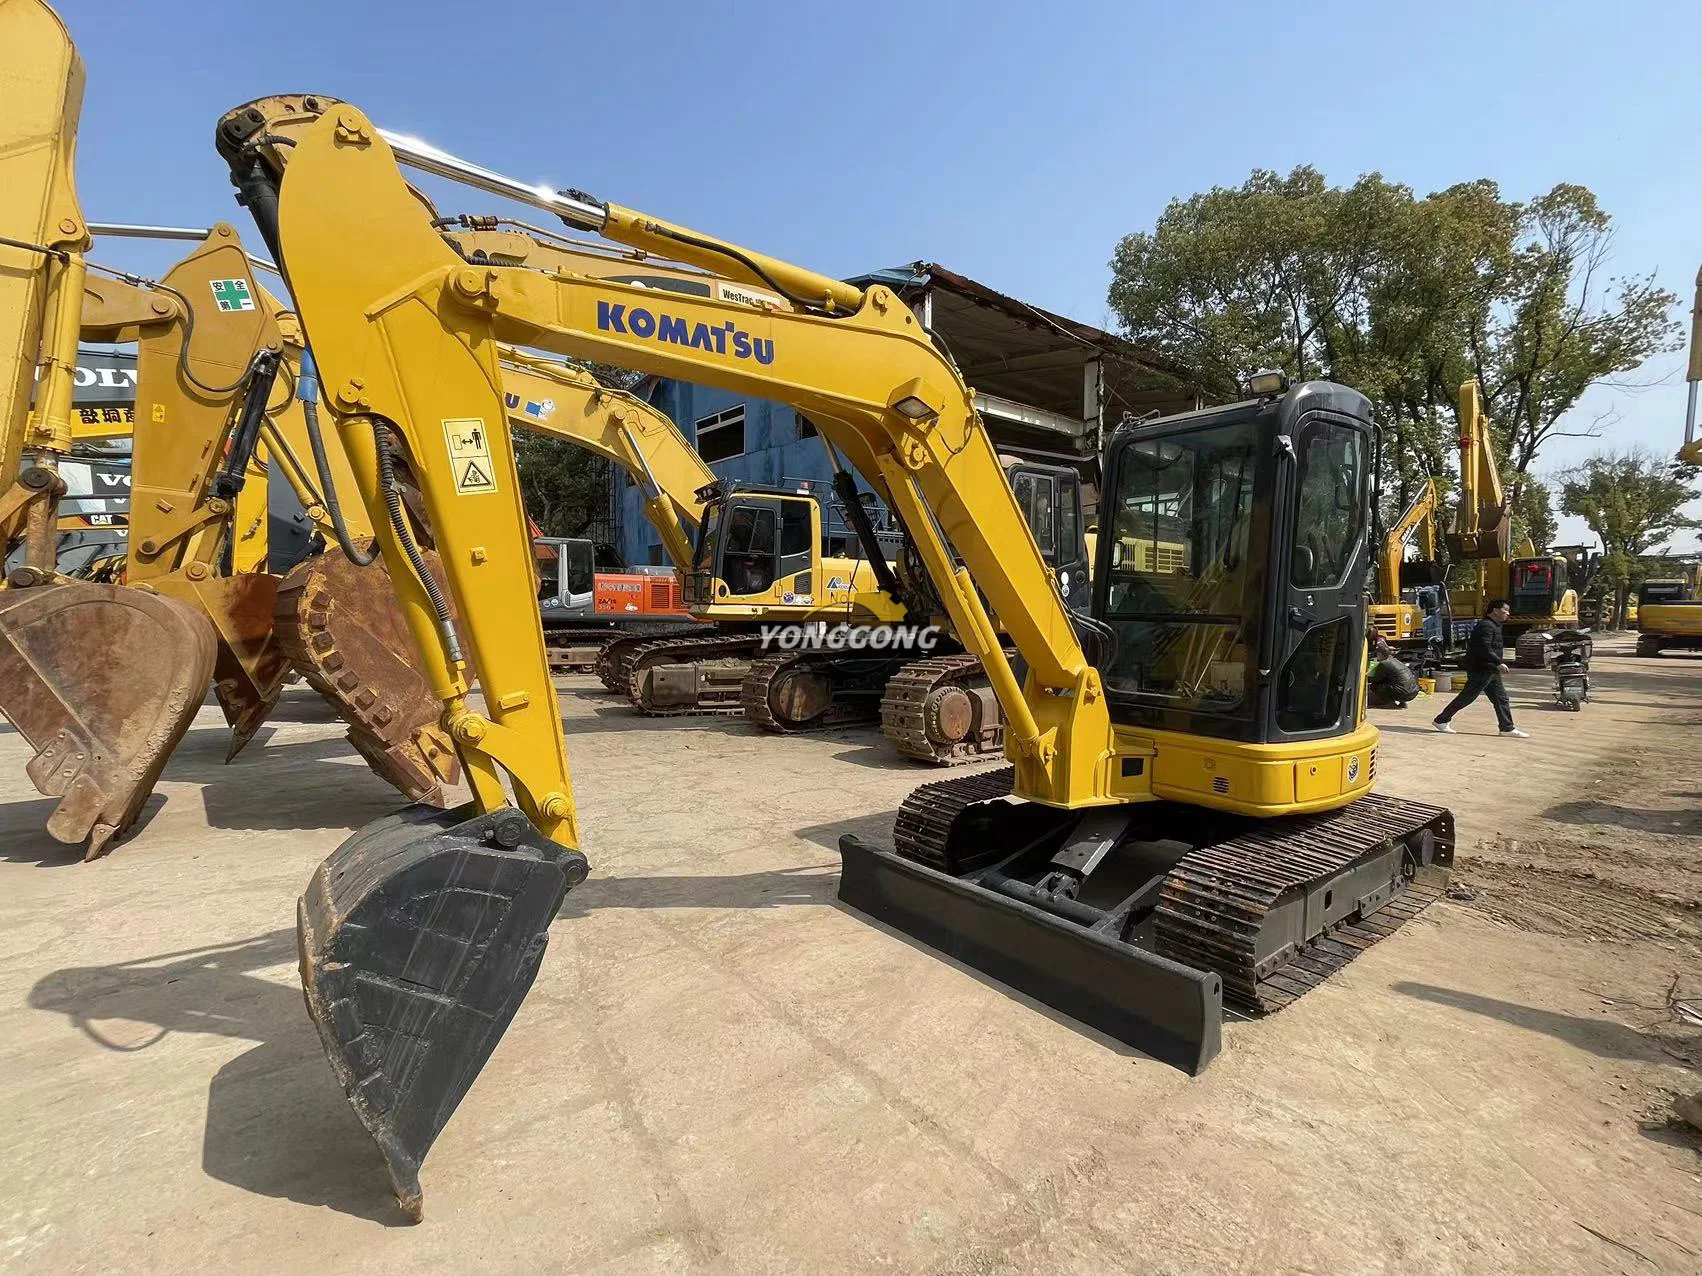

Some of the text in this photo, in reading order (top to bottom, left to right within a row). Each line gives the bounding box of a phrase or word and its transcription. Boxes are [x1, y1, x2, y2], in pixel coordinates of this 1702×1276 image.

[212, 280, 246, 291] 安全
[597, 300, 775, 365] KOMATSU
[90, 514, 113, 525] CAT
